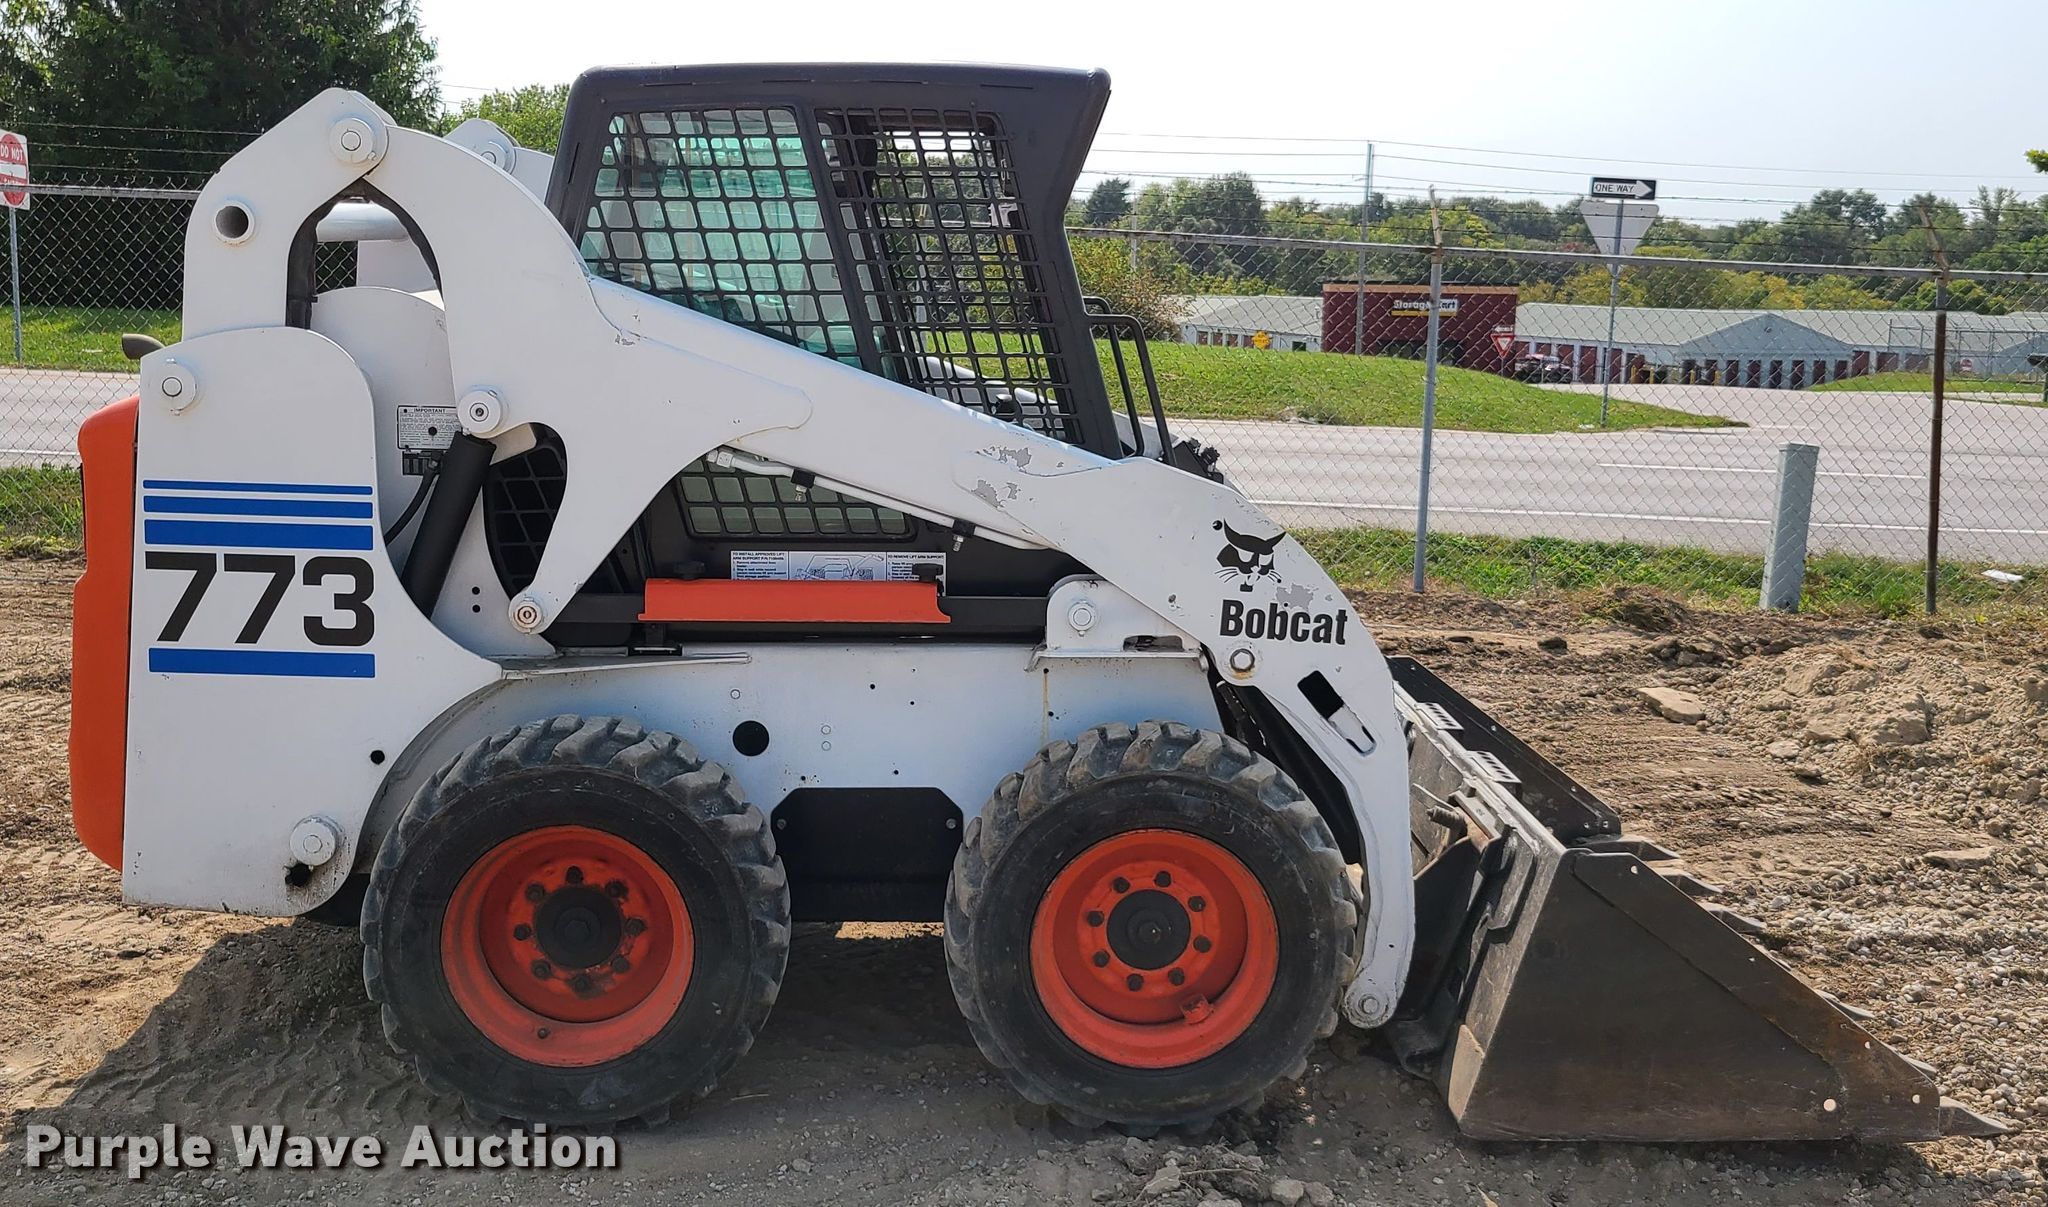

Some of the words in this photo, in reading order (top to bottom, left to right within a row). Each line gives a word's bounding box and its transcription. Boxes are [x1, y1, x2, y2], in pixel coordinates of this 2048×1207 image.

[1, 145, 9, 158] DO
[11, 147, 23, 160] NOT
[1595, 183, 1613, 192] ONE
[1616, 184, 1634, 193] WAY
[145, 551, 374, 646] 773
[1220, 599, 1348, 645] Bobcat
